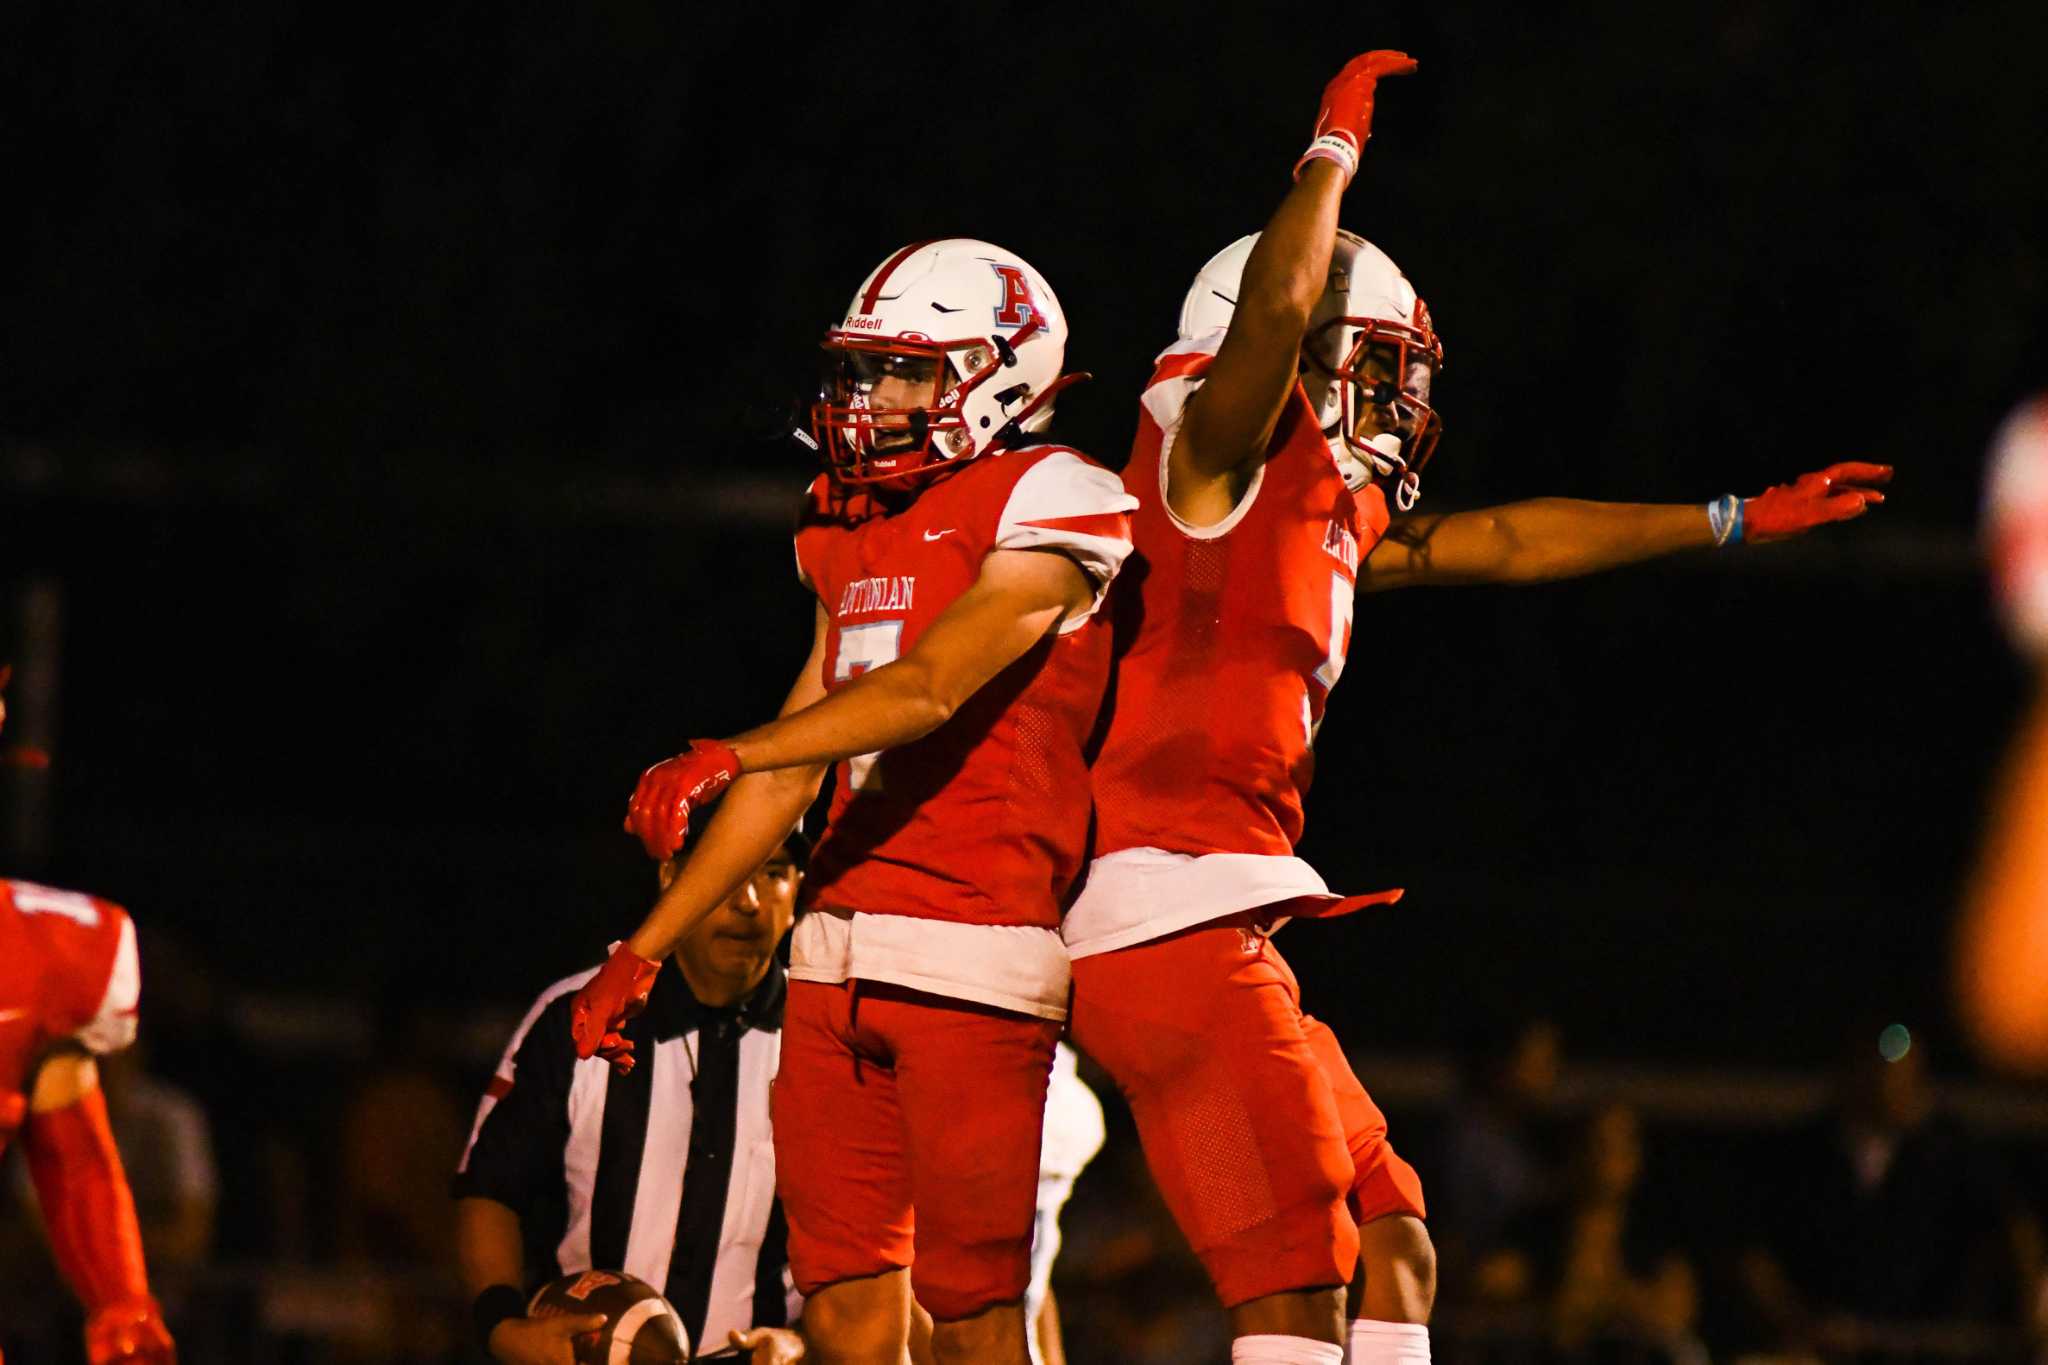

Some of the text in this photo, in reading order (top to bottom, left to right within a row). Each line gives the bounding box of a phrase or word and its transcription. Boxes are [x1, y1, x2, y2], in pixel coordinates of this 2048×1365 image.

[991, 264, 1049, 332] A
[846, 316, 883, 330] Riddell
[838, 576, 915, 617] ANTONIAN
